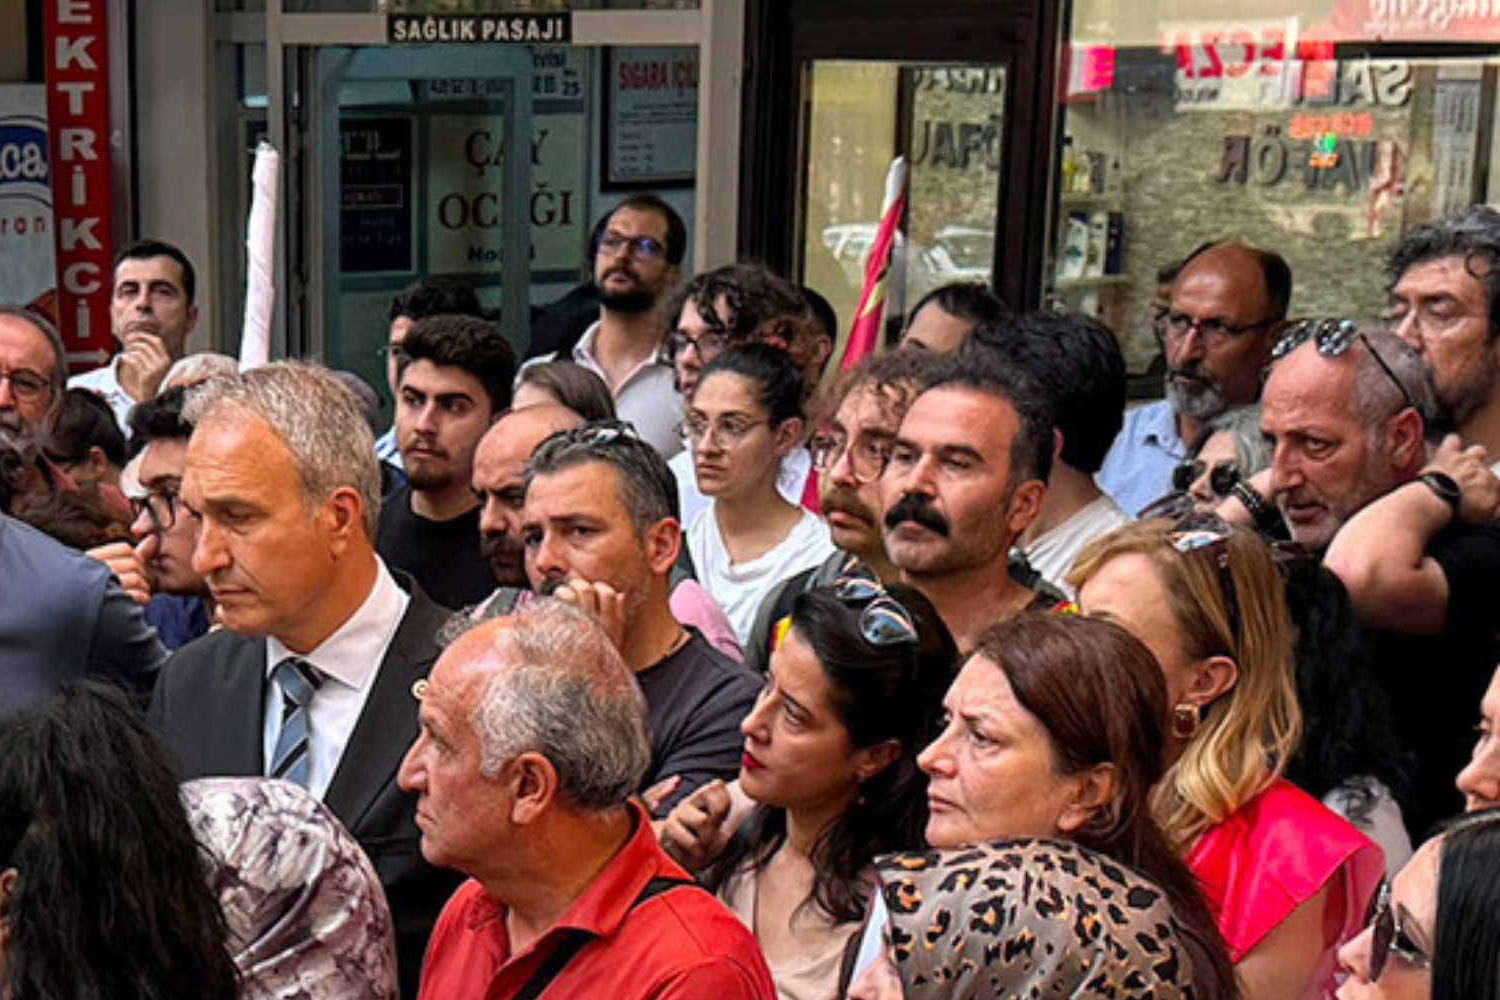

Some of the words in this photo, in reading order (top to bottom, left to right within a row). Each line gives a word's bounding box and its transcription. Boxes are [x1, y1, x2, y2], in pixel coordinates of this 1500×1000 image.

[393, 17, 476, 42] SAĞLIK
[482, 17, 563, 41] PASAJI
[438, 182, 573, 230] OCĞI
